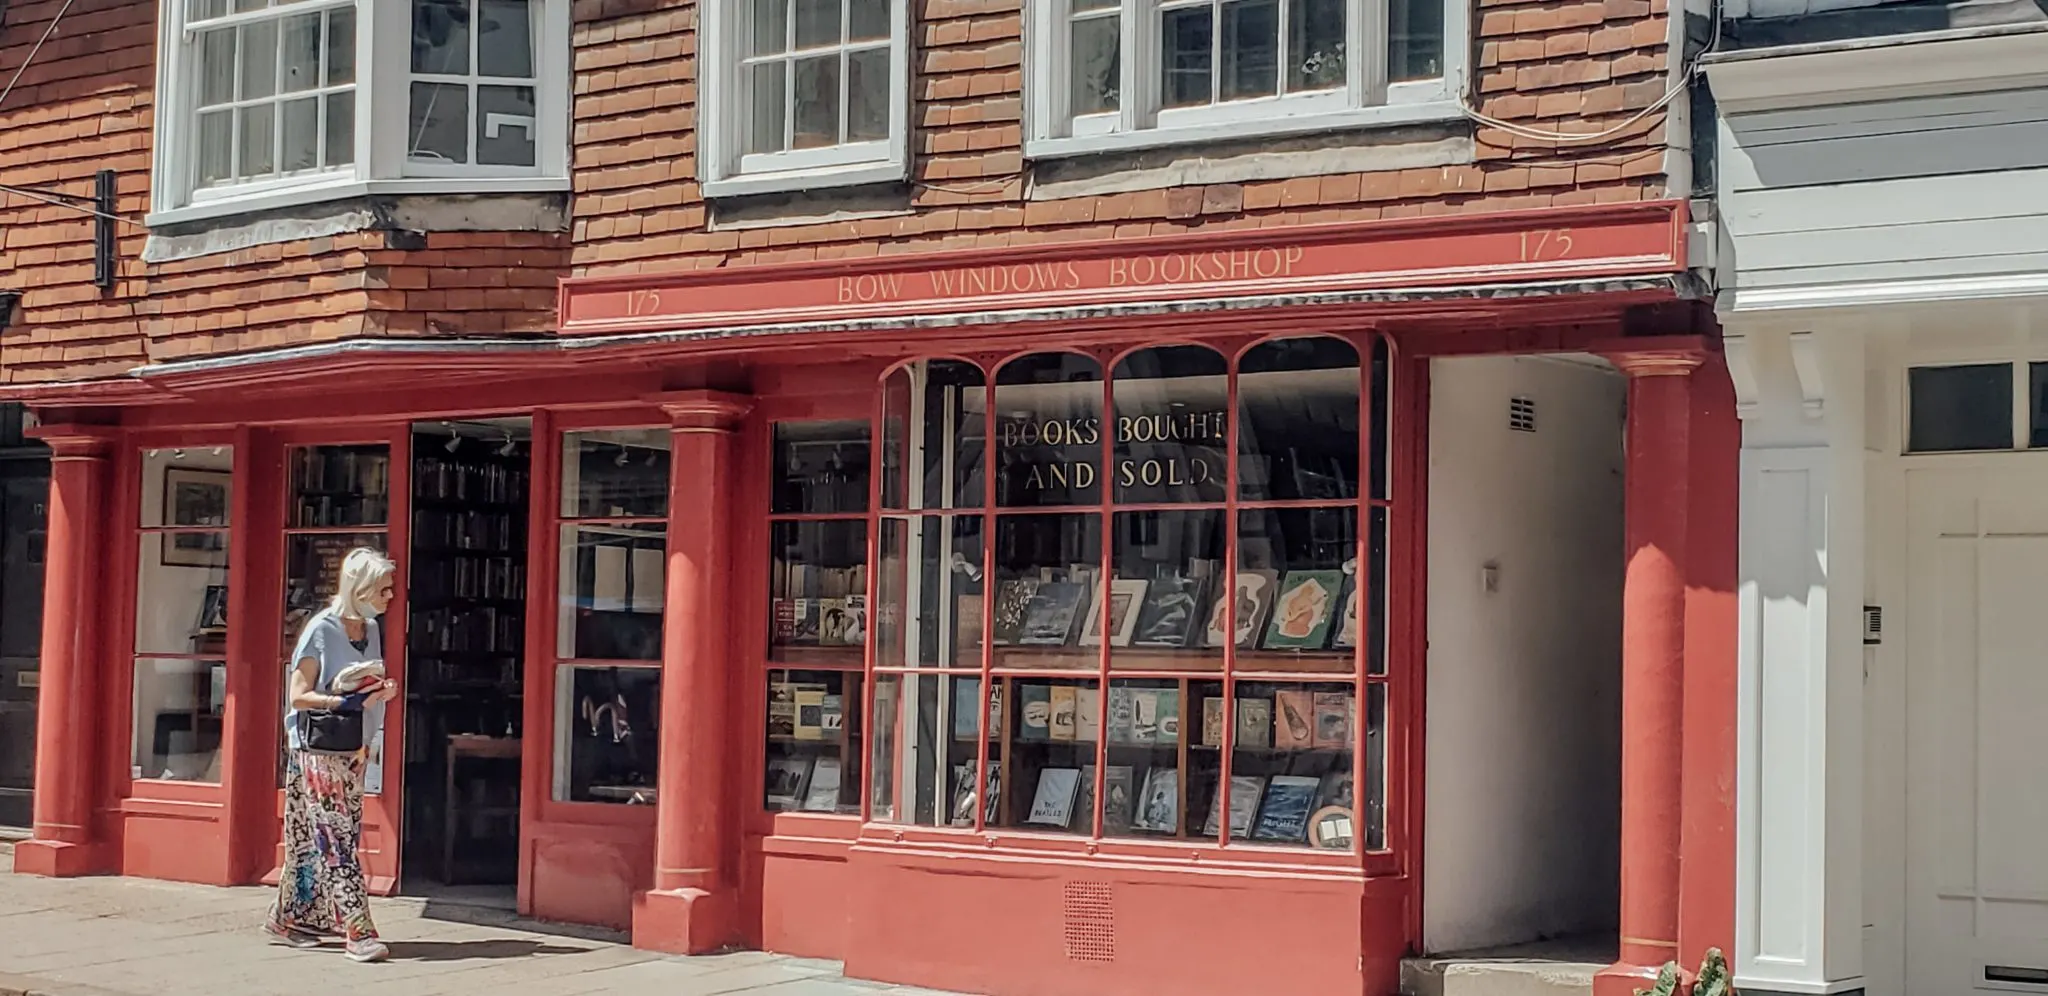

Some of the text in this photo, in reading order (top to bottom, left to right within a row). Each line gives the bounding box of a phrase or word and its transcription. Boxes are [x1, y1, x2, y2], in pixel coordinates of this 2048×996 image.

[1520, 228, 1572, 262] 175
[838, 244, 1304, 302] BOW WINDOWS BOOKSHOP
[628, 289, 660, 315] 175
[1004, 411, 1225, 447] BOOKS BOUGHT
[1025, 458, 1208, 489] AND SOLD
